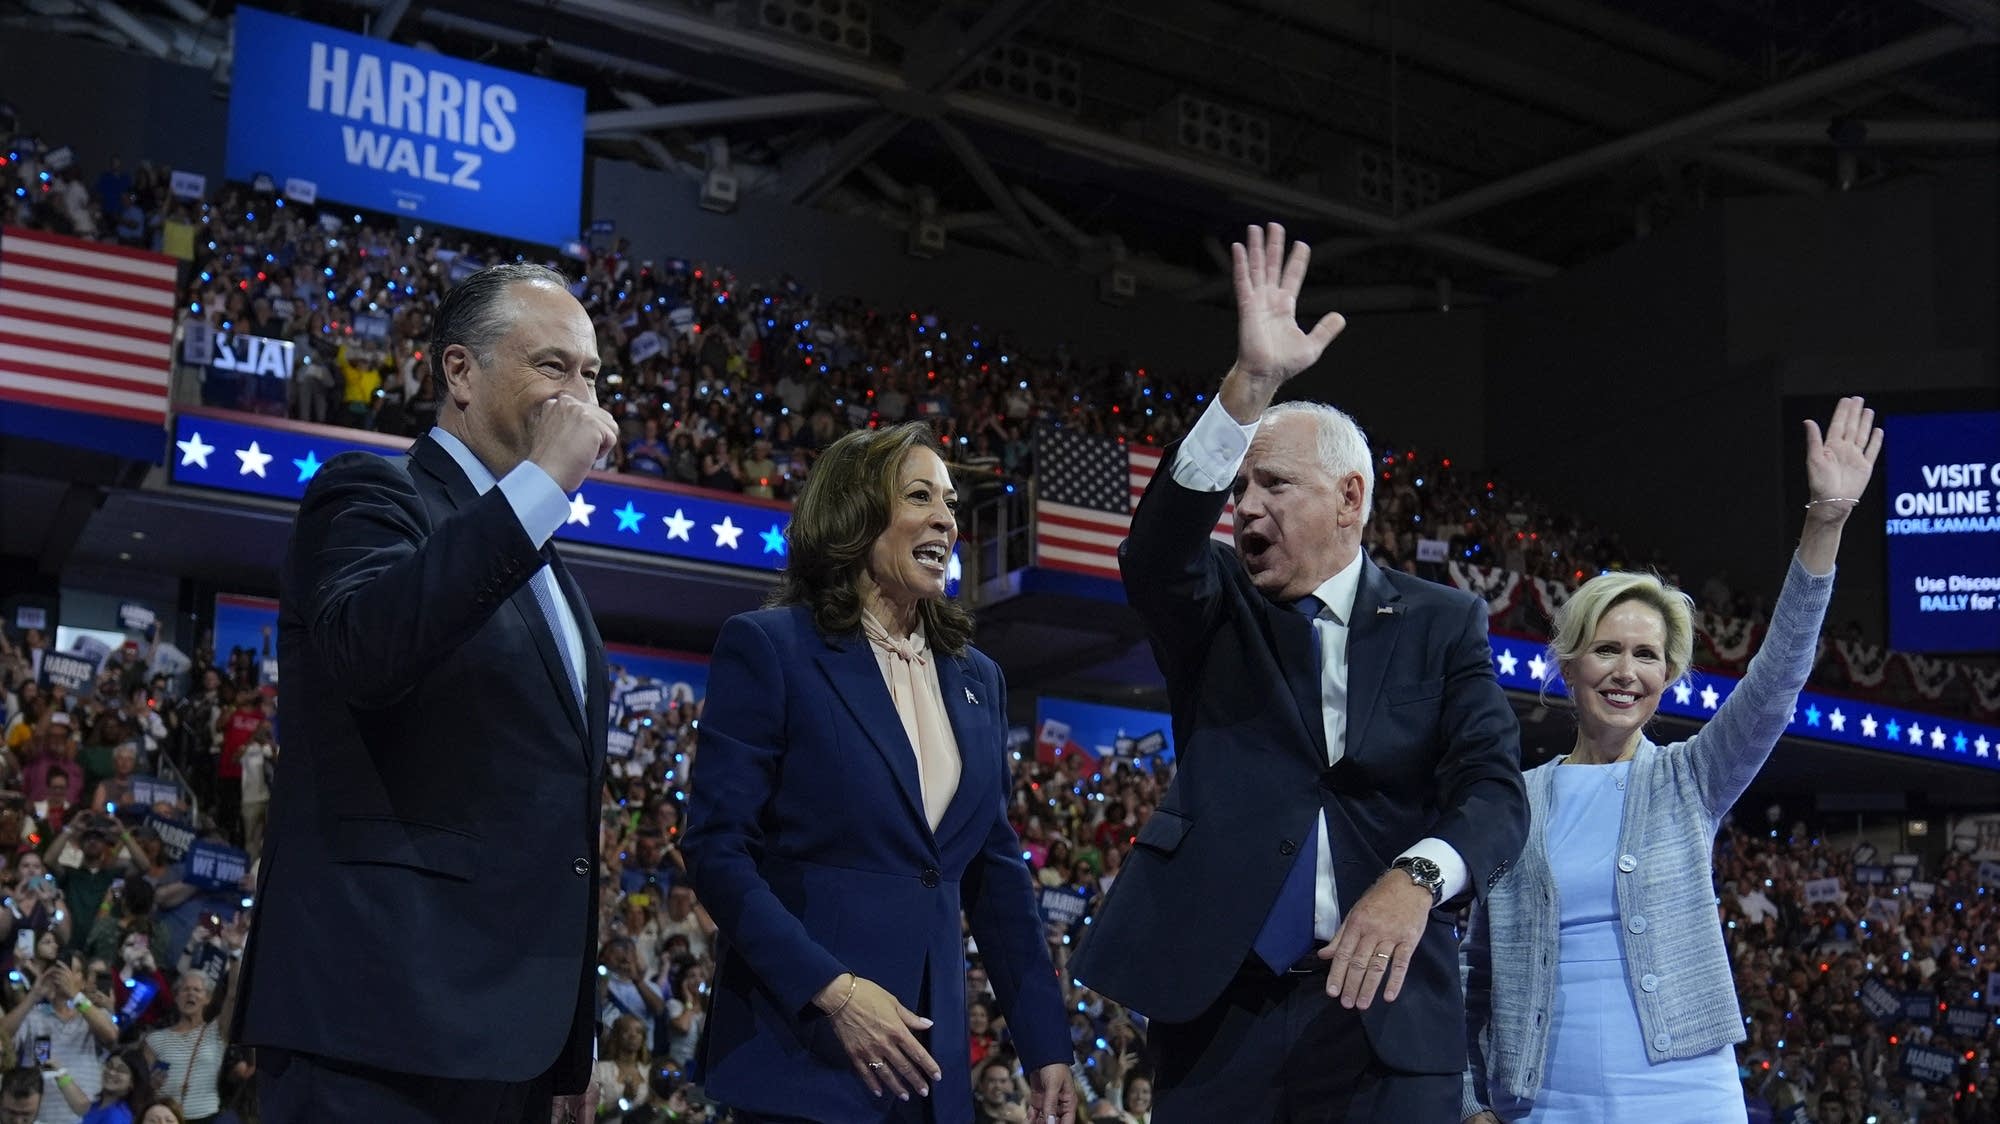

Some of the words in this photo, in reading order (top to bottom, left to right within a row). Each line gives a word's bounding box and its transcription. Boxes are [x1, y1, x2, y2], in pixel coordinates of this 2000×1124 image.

[308, 41, 517, 153] HARRIS
[342, 125, 482, 191] WALZ
[1922, 463, 1986, 488] VISIT
[1895, 490, 1991, 516] ONLINE
[1915, 576, 1947, 592] Use
[1920, 594, 1969, 611] RALLY
[1970, 593, 1996, 610] for
[43, 655, 93, 682] HARRIS
[193, 855, 216, 879] WE
[216, 861, 245, 882] WIN
[1042, 890, 1085, 914] HARRIS
[1905, 1048, 1954, 1076] HARRIS
